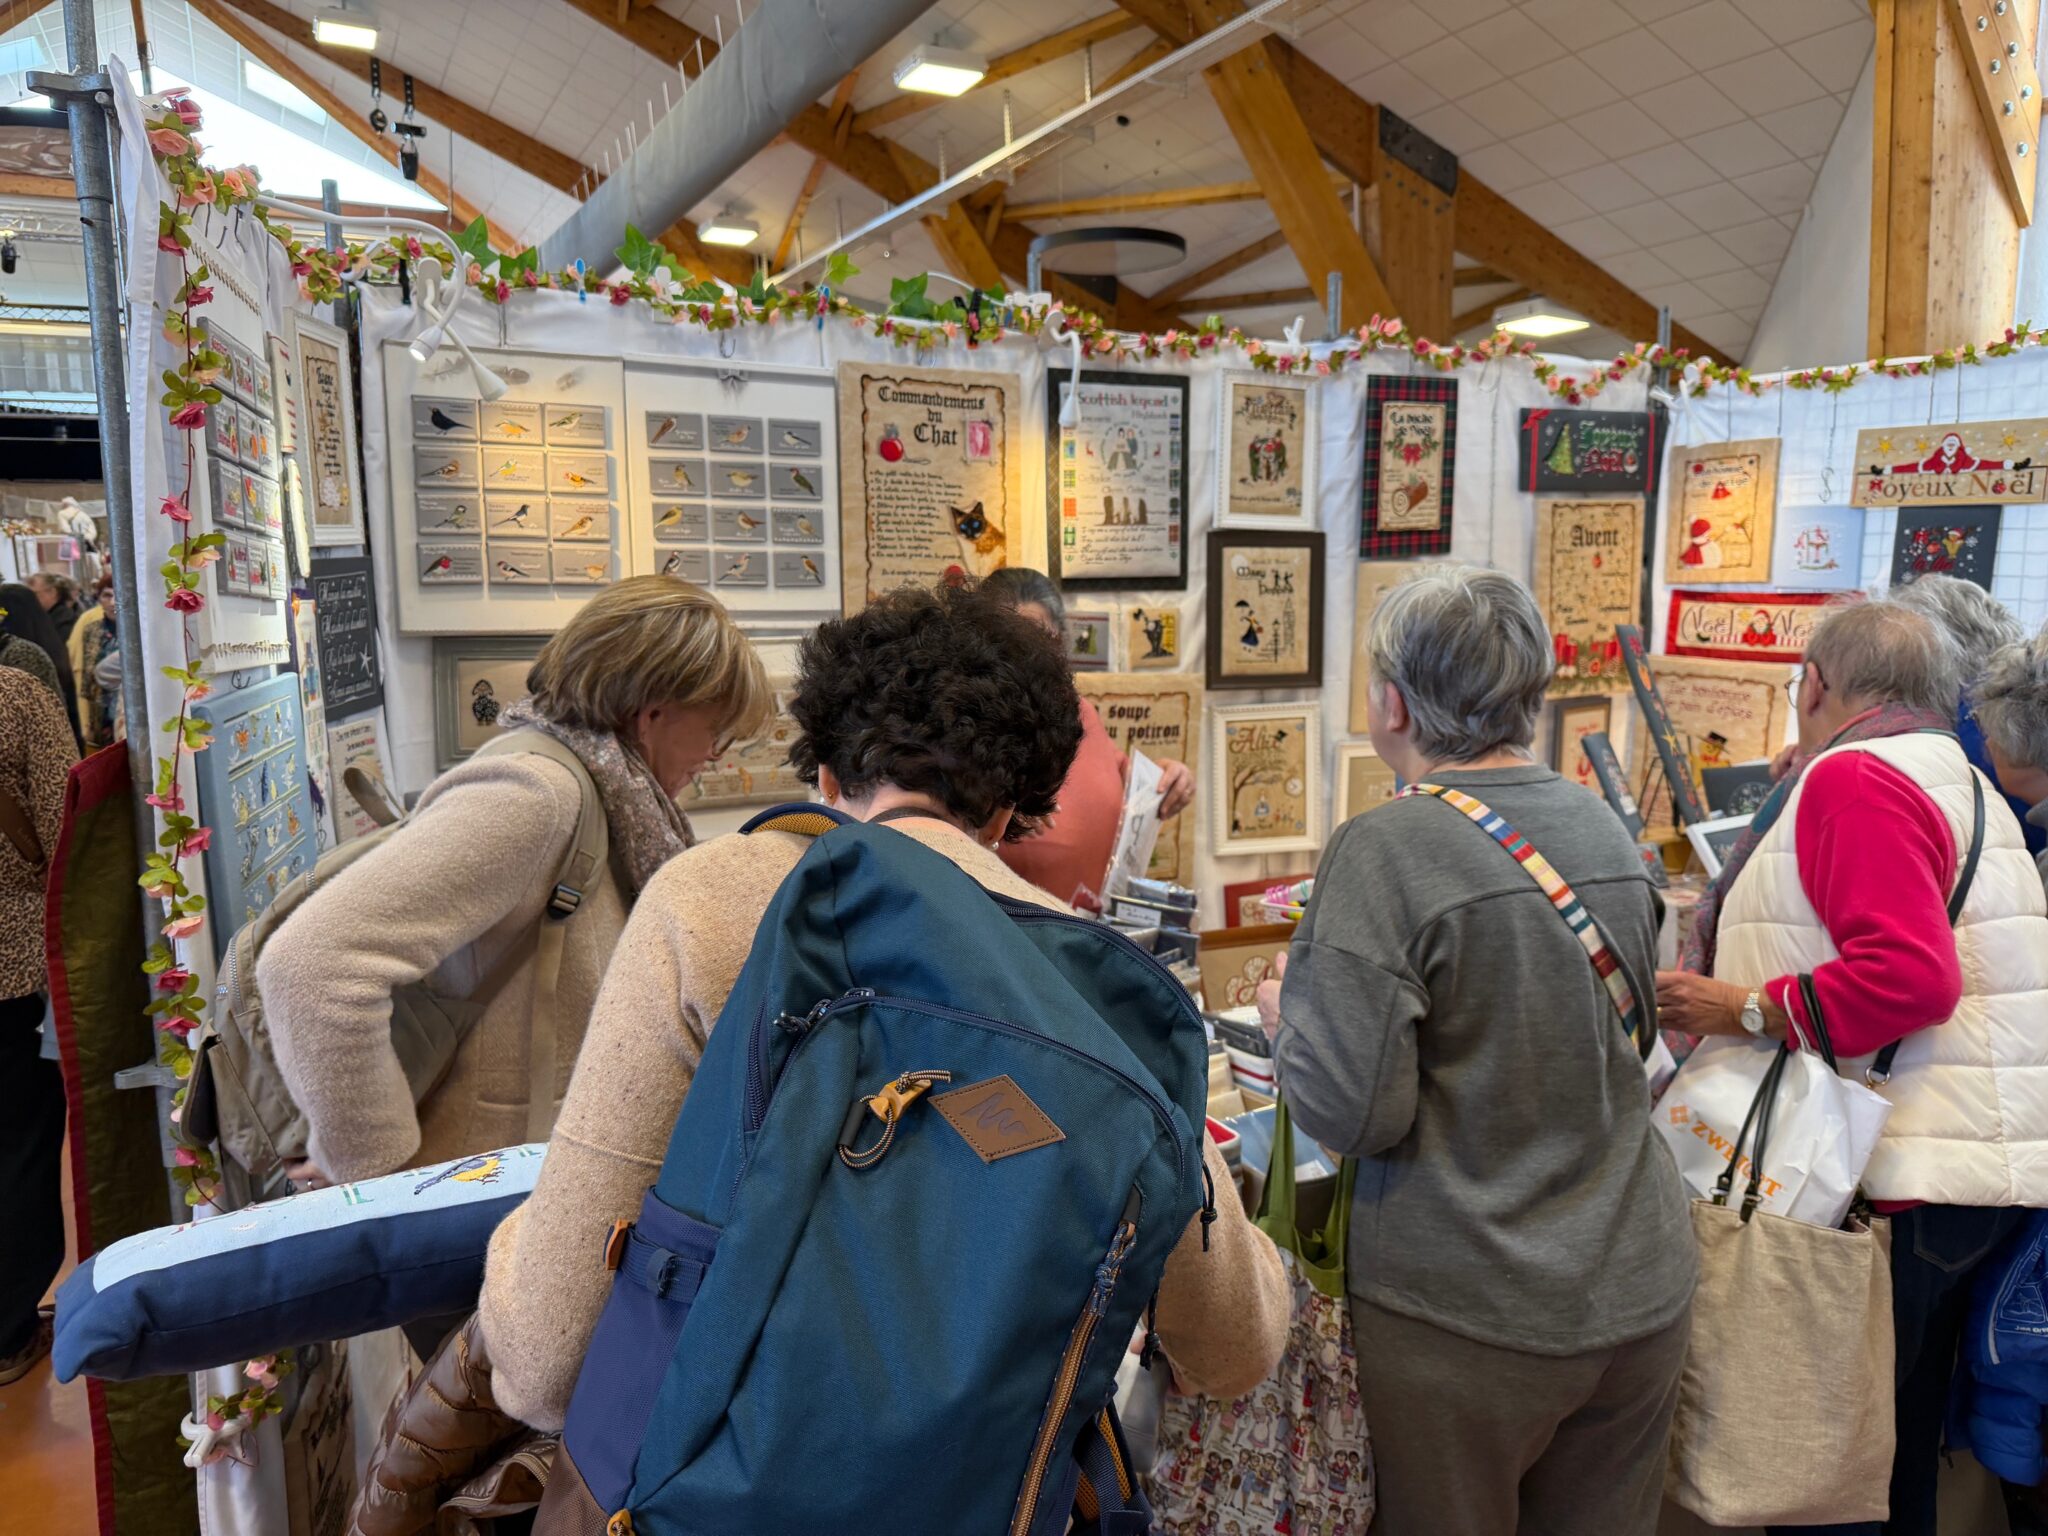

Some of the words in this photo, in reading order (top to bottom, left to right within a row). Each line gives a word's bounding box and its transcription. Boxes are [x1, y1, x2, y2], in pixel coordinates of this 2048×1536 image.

[878, 386, 985, 410] Commandements
[928, 408, 943, 423] du
[914, 422, 958, 447] Chat
[1967, 471, 2034, 497] Noël
[1571, 525, 1618, 547] Avent
[1681, 604, 1734, 641] Noël
[1772, 608, 1815, 636] Noë
[1108, 703, 1151, 721] soupe
[1127, 723, 1180, 742] potiron
[1691, 1120, 1784, 1197] ZWEIGT
